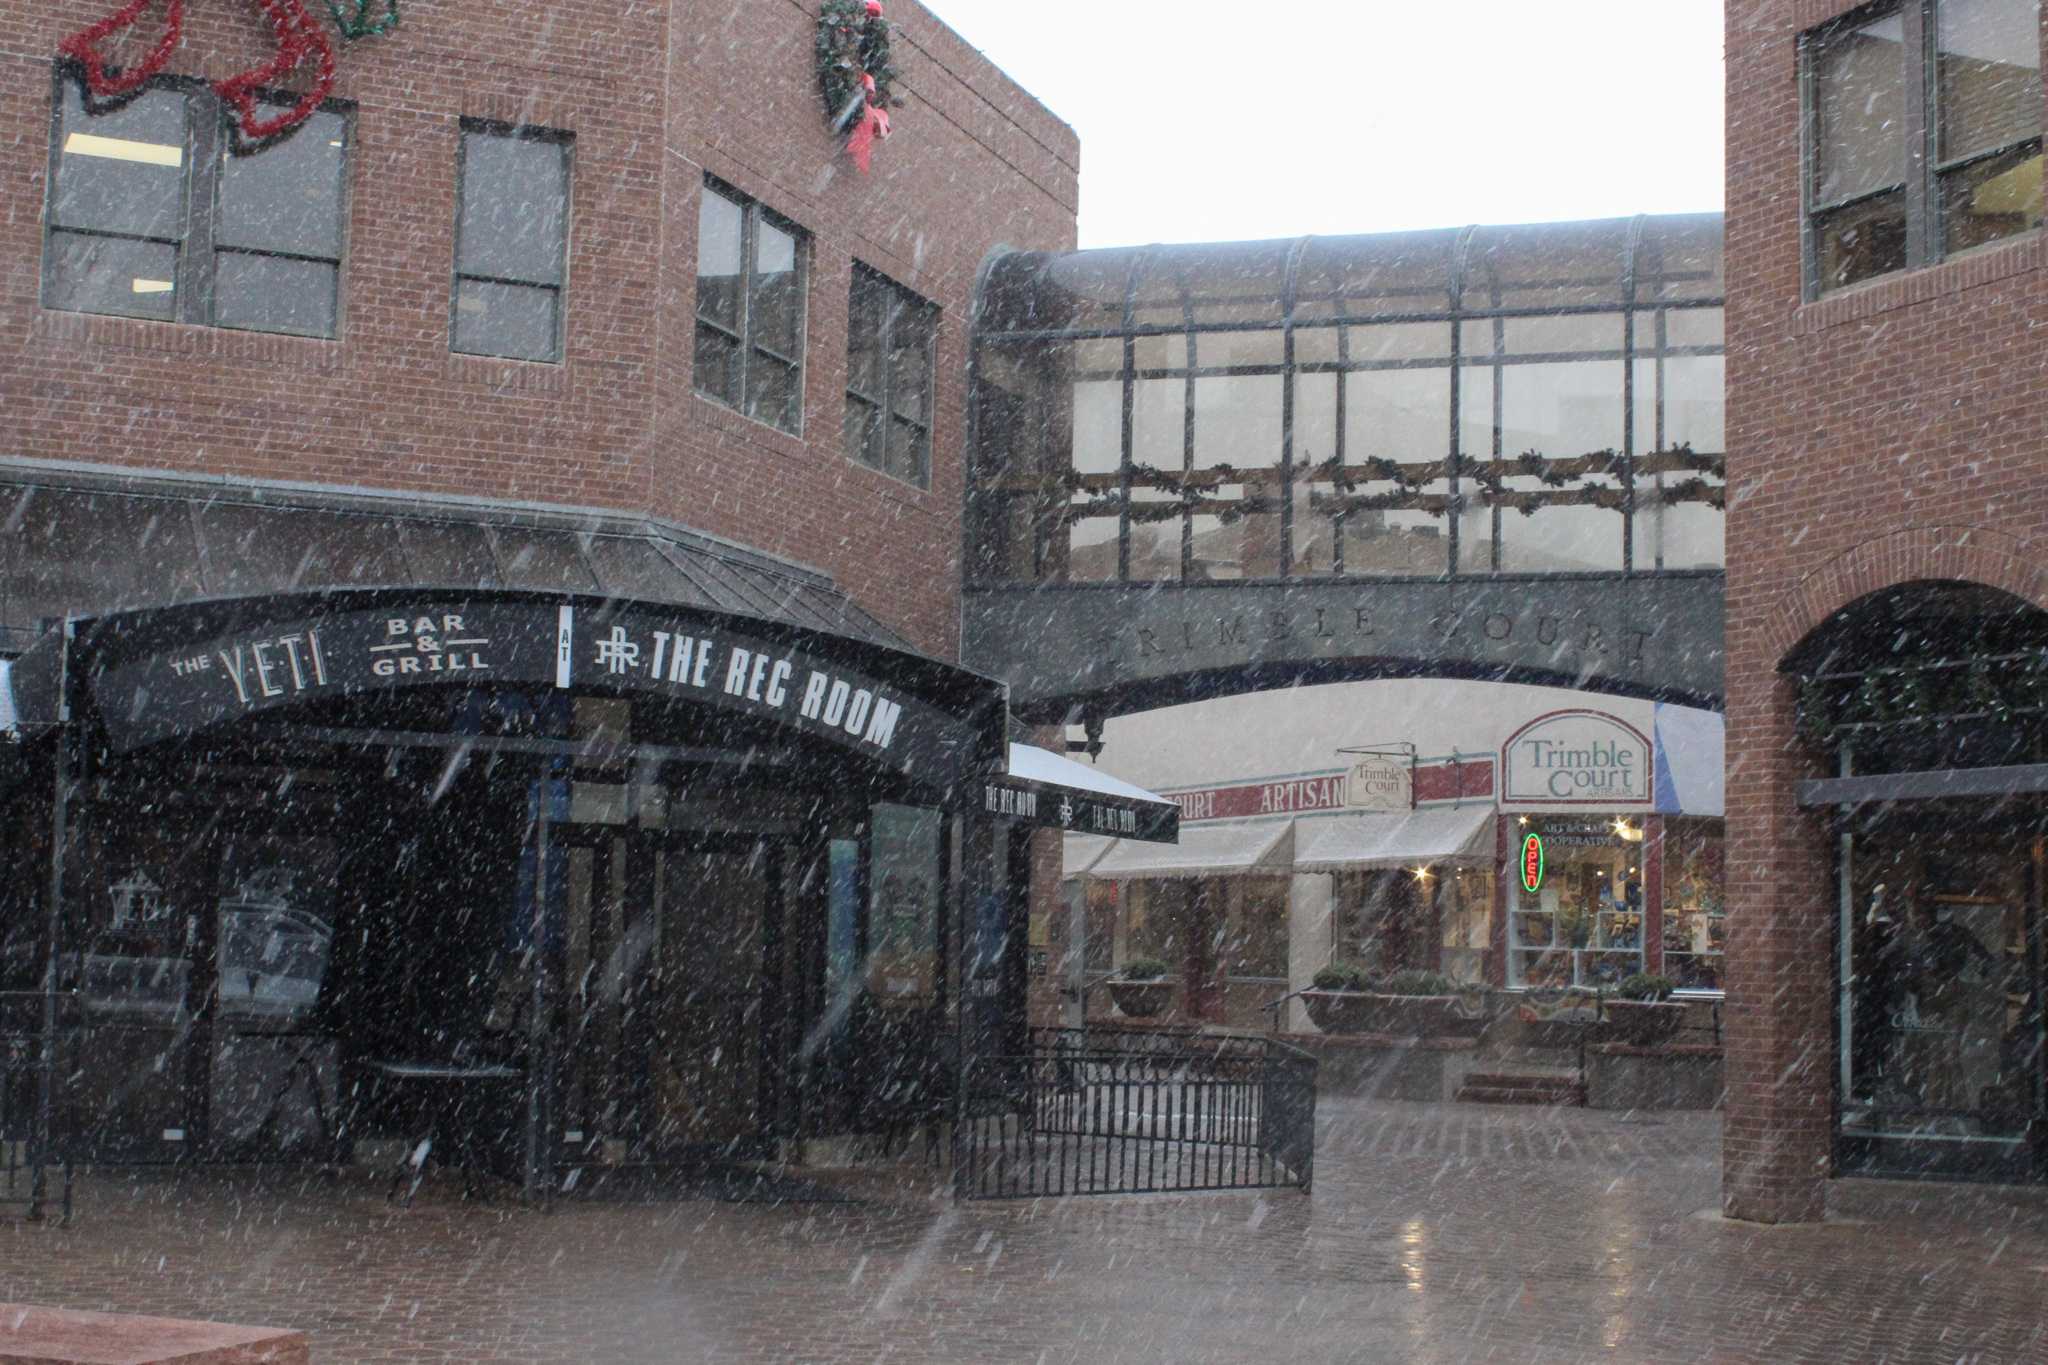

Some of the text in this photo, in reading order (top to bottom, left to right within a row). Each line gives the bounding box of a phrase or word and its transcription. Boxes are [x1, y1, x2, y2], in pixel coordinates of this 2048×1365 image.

[387, 615, 464, 635] BAR
[1434, 610, 1653, 661] COURT
[416, 636, 441, 652] &
[561, 629, 569, 662] AT
[170, 627, 327, 703] THE YETI
[373, 652, 489, 676] GRILL
[651, 631, 901, 749] THE REC ROOM
[1522, 740, 1634, 769] Trimble
[1355, 764, 1401, 781] Trimble
[1548, 769, 1633, 797] Court
[1365, 780, 1400, 796] Court
[1527, 837, 1539, 887] OPEN
